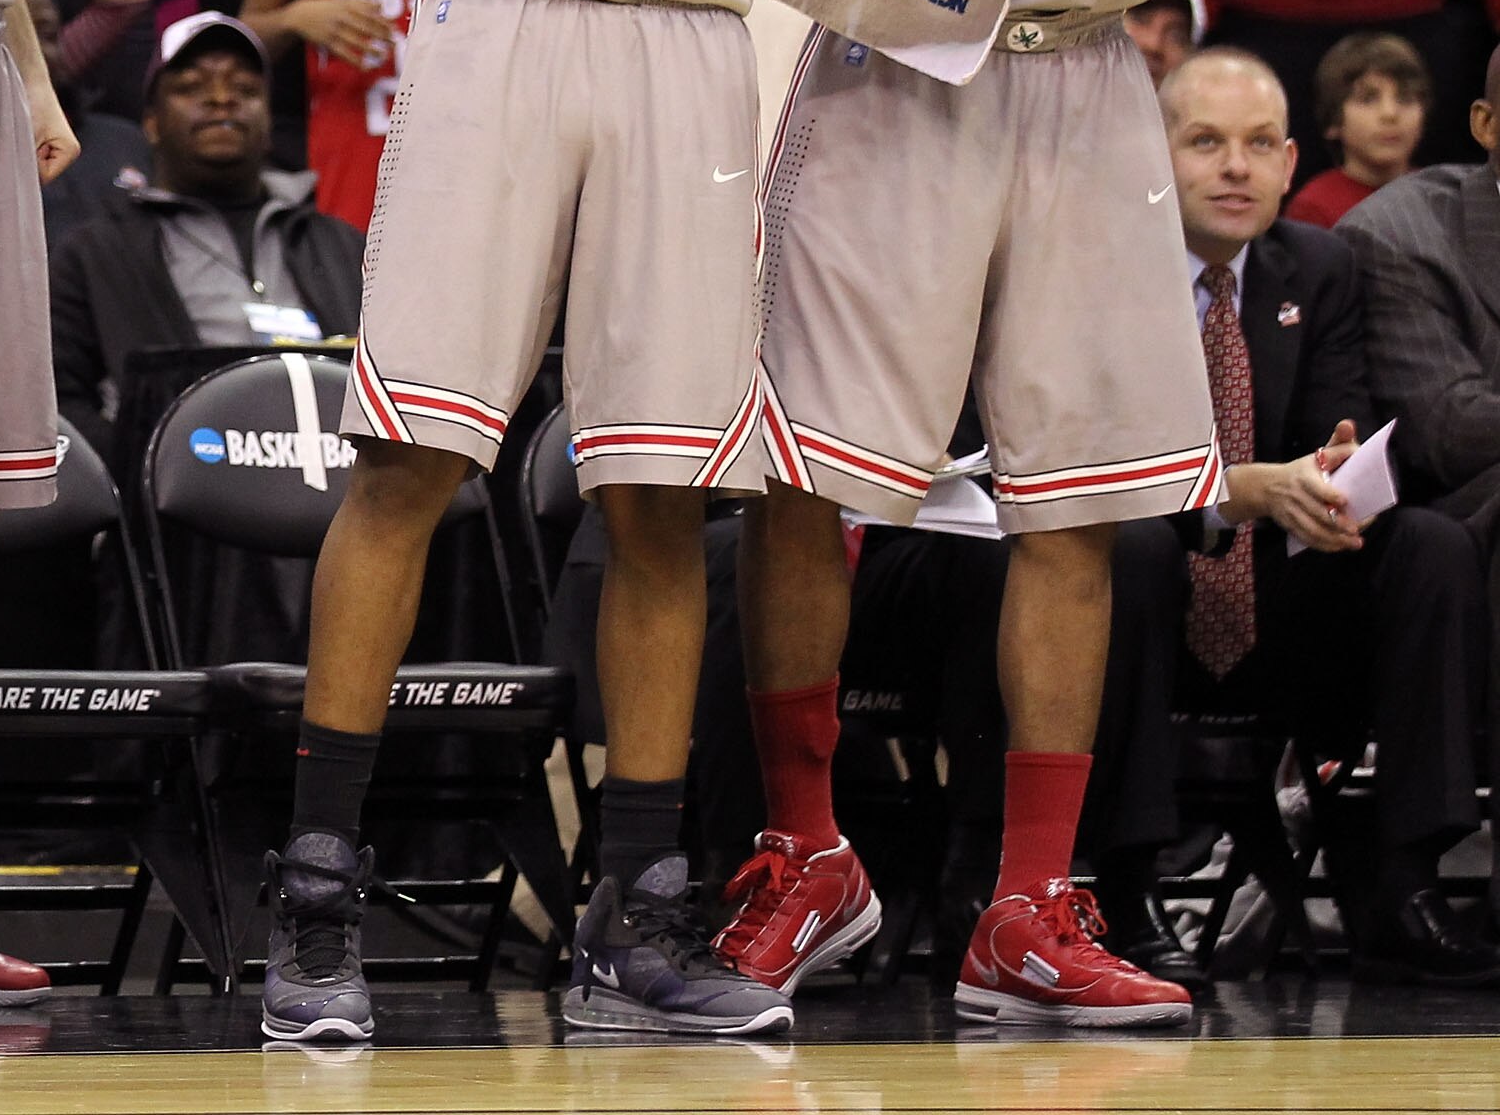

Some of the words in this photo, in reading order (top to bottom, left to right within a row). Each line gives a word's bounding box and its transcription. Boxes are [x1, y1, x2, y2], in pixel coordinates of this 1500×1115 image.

[40, 687, 86, 711] THE
[87, 688, 155, 712] GAME
[404, 682, 450, 706] THE
[451, 682, 518, 706] GAME
[842, 689, 903, 711] GAME
